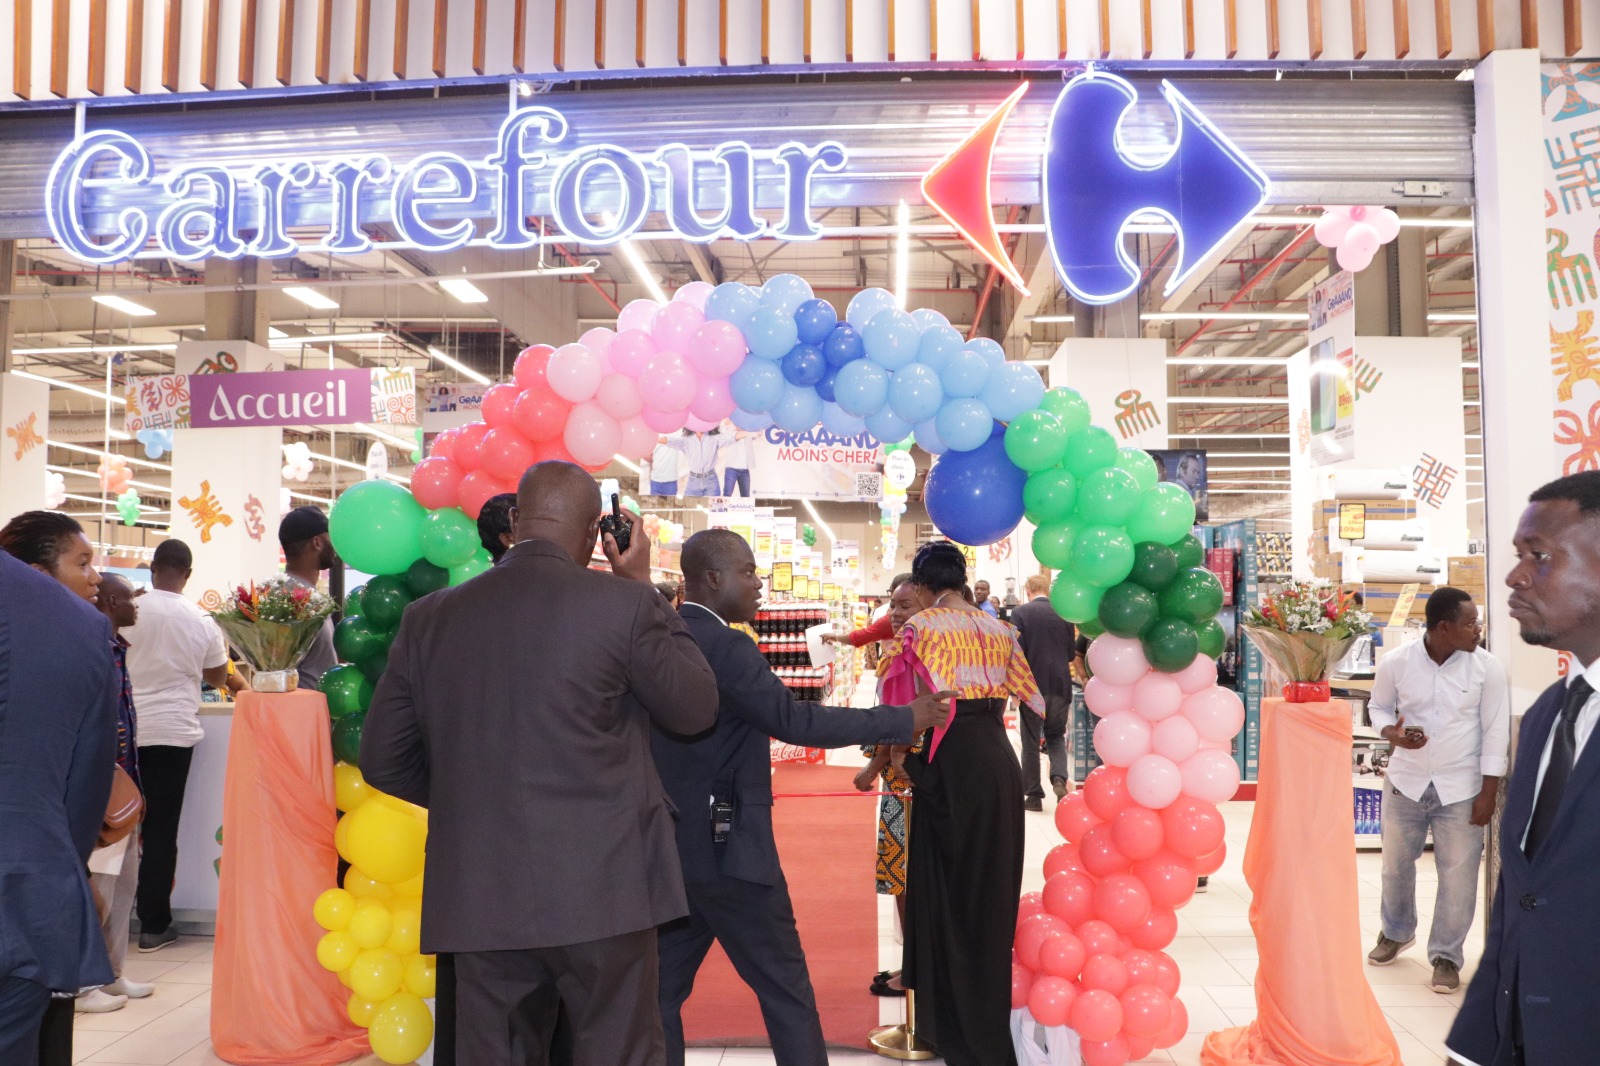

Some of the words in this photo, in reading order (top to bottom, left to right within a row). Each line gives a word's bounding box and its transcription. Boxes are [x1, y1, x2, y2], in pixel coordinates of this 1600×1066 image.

[45, 105, 849, 264] Carrefour
[209, 379, 346, 421] Accueil
[765, 424, 880, 449] GRAAAND
[777, 448, 828, 462] MOINS
[832, 449, 878, 464] CHER!
